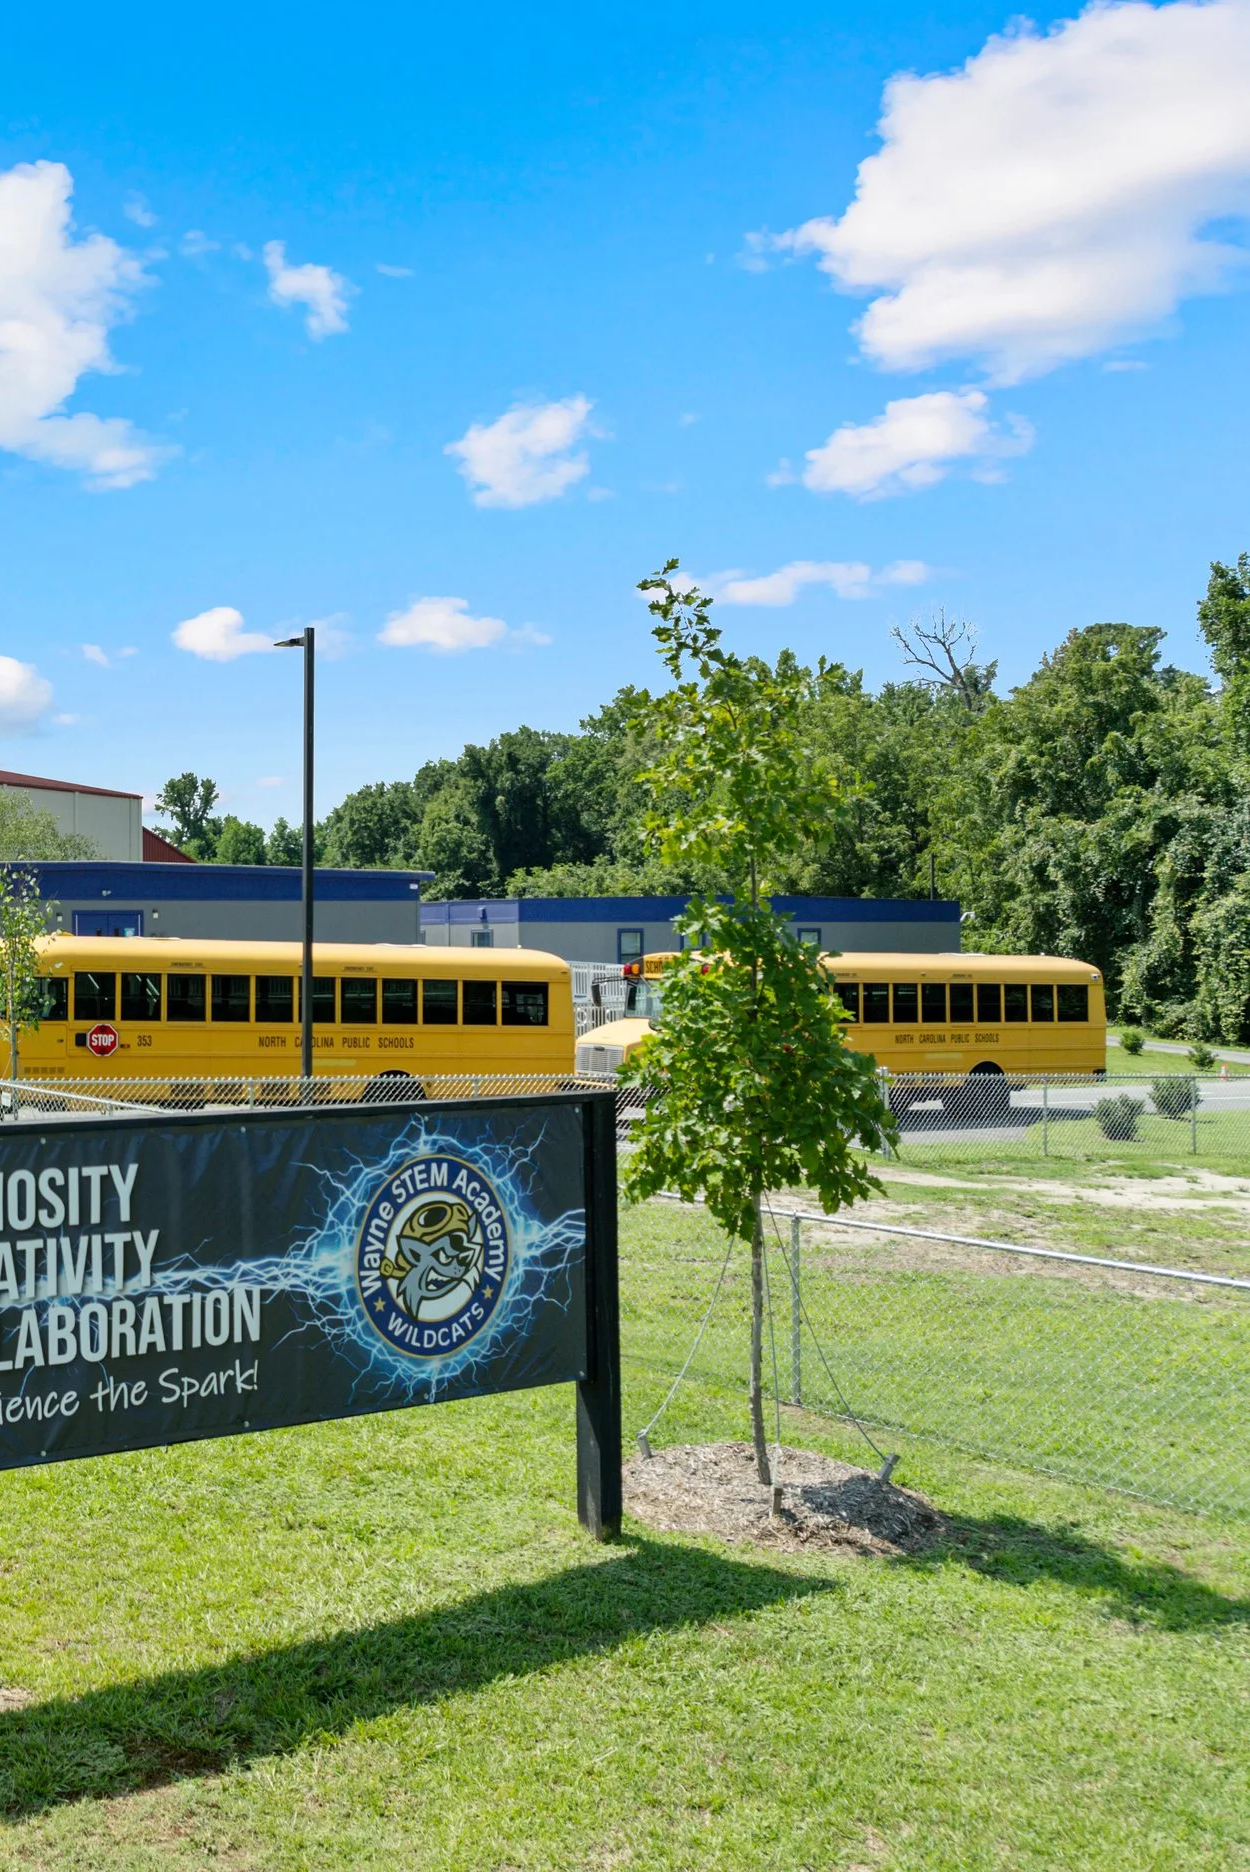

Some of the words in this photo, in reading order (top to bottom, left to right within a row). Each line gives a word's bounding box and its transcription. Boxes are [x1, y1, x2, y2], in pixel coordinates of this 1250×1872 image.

[645, 960, 663, 973] SCHO
[91, 1034, 115, 1046] STOP
[137, 1035, 152, 1047] 353
[258, 1036, 286, 1048] NORTH
[294, 1036, 334, 1048] COLINA
[342, 1037, 371, 1048] PUBLIC
[378, 1037, 414, 1048] SCHOOLS
[895, 1034, 914, 1044] NORTH
[919, 1034, 946, 1044] CAROLINA
[950, 1034, 970, 1043] PUBLIC
[975, 1033, 1000, 1043] SCHOOLS
[359, 1201, 395, 1298] Wayne
[391, 1162, 448, 1204] STEM
[452, 1168, 505, 1282] Academy
[387, 1302, 485, 1348] WILDCATS
[90, 1375, 148, 1412] the
[158, 1359, 259, 1407] Spark!
